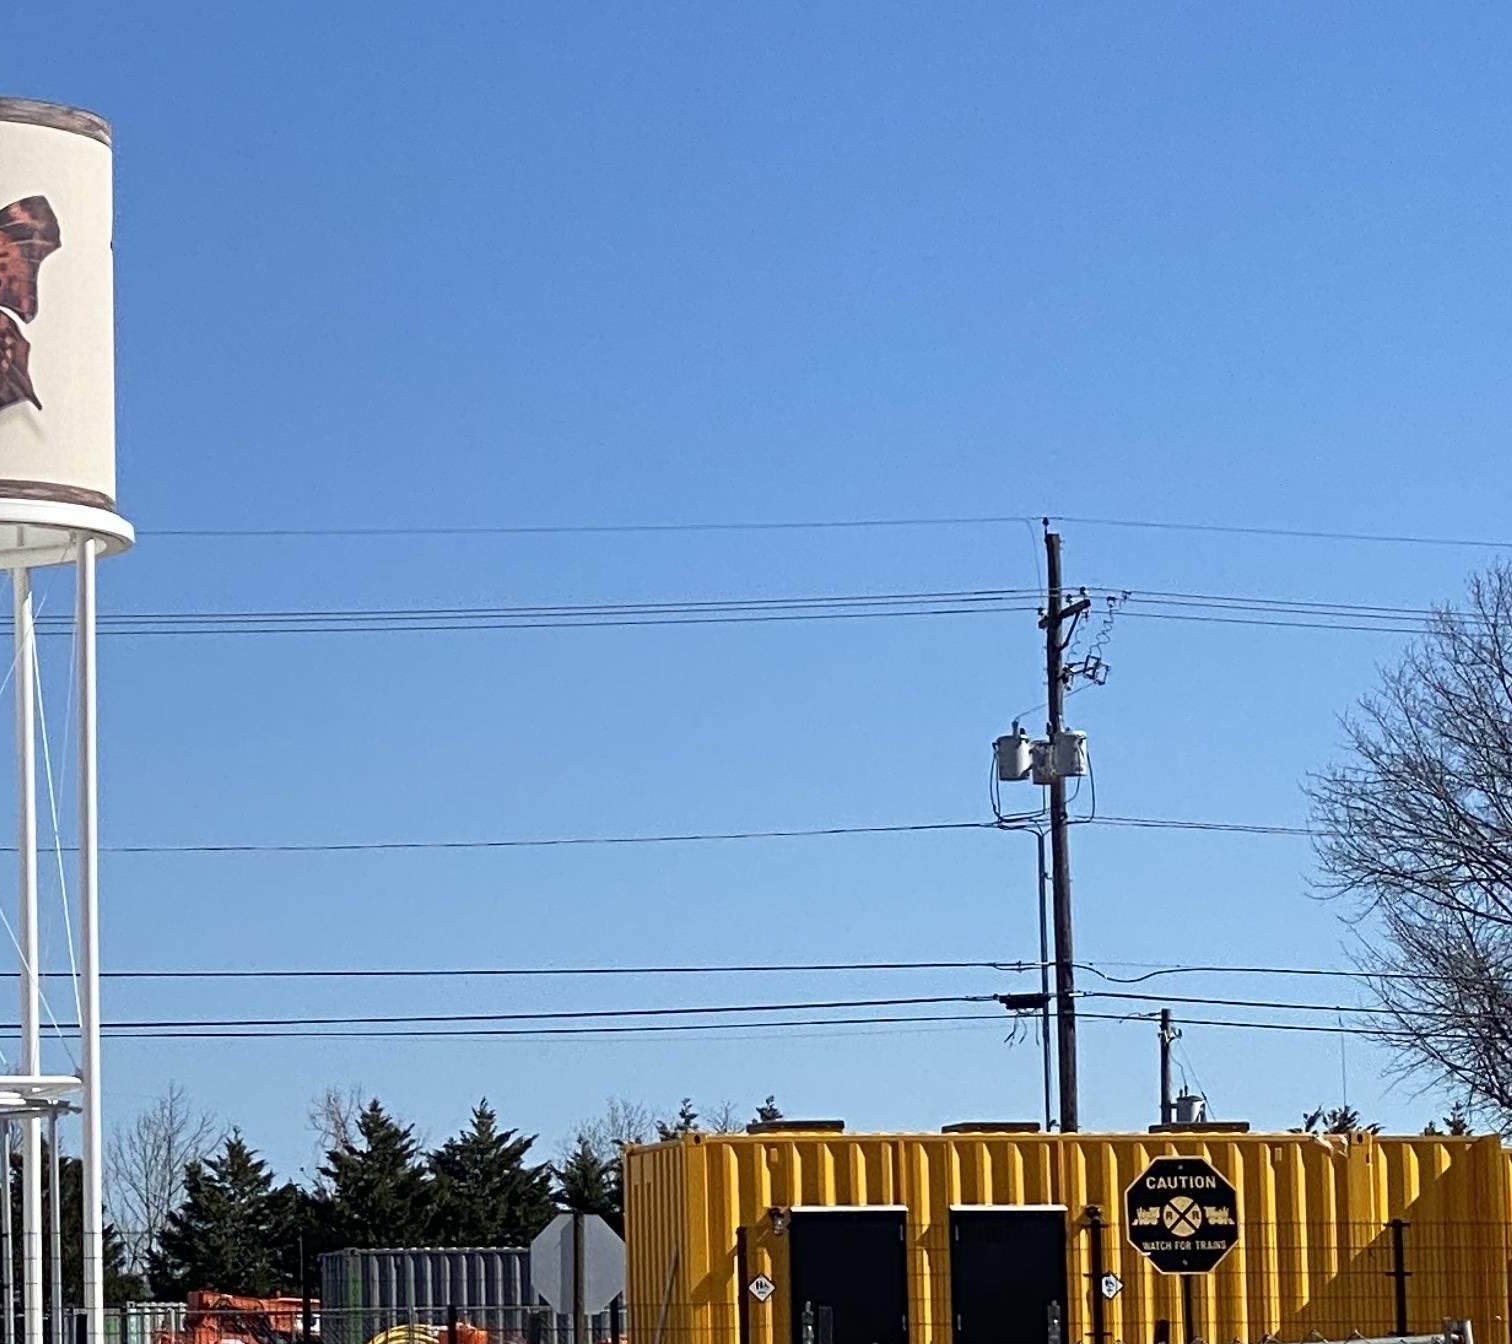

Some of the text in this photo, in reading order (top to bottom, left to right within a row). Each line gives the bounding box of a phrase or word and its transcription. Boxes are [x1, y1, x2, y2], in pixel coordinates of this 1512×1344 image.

[1146, 1176, 1216, 1189] CAUTION
[1142, 1240, 1227, 1250] WATCH FOR TRAINS
